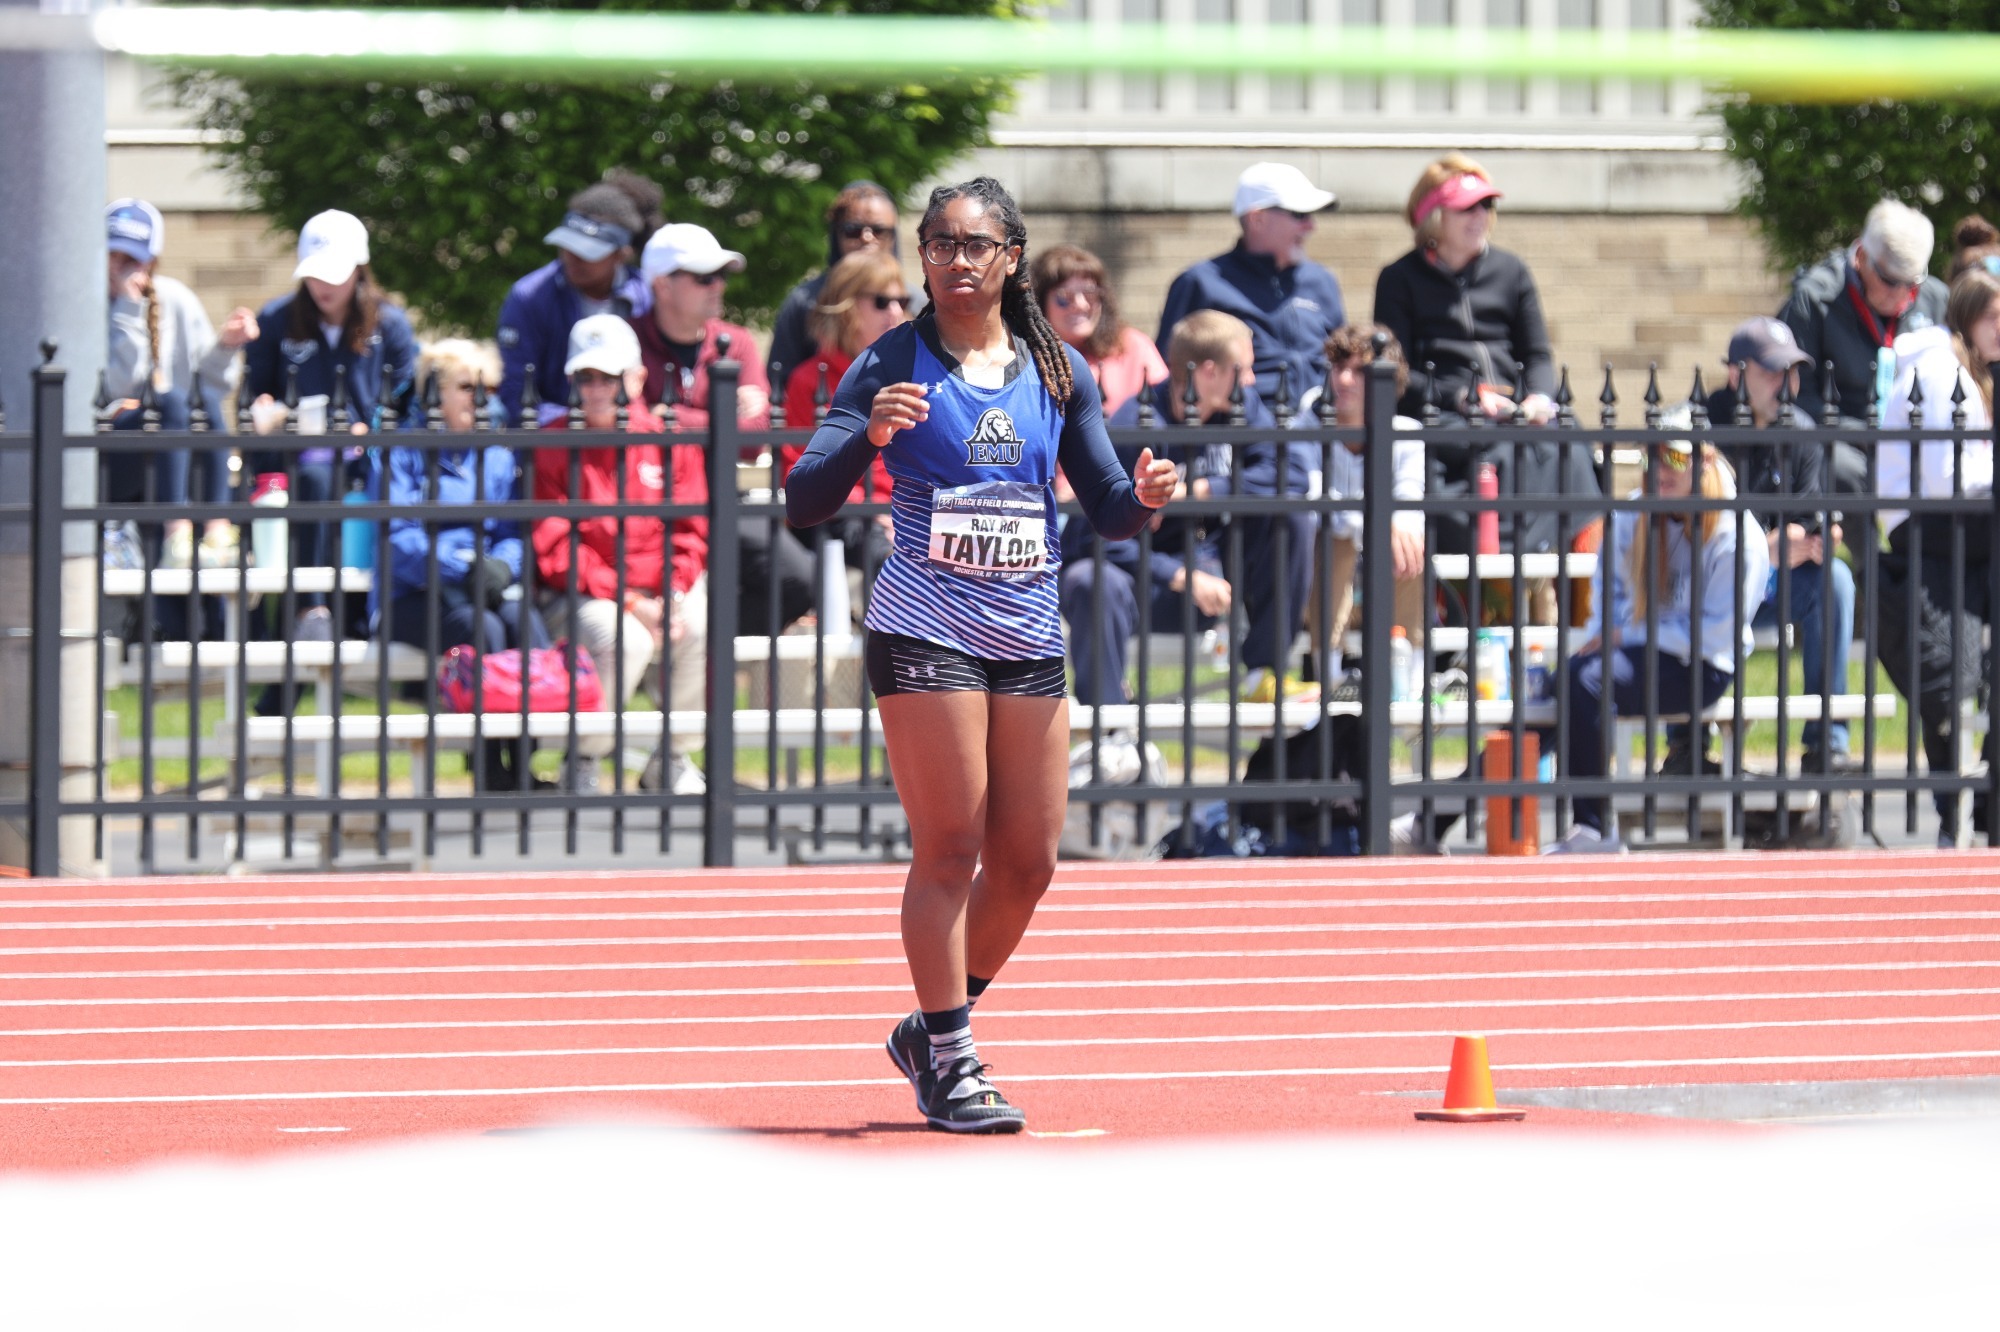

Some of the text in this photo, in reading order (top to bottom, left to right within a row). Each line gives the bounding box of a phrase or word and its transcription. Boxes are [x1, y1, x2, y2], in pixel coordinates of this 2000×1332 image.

[971, 444, 1019, 463] EMU
[954, 497, 976, 506] TRACK
[977, 499, 982, 507] &
[982, 499, 1001, 508] FIELD
[971, 518, 1020, 534] RAY RAY
[941, 532, 1039, 568] TAYLOR
[953, 566, 985, 577] ROCHESTER,
